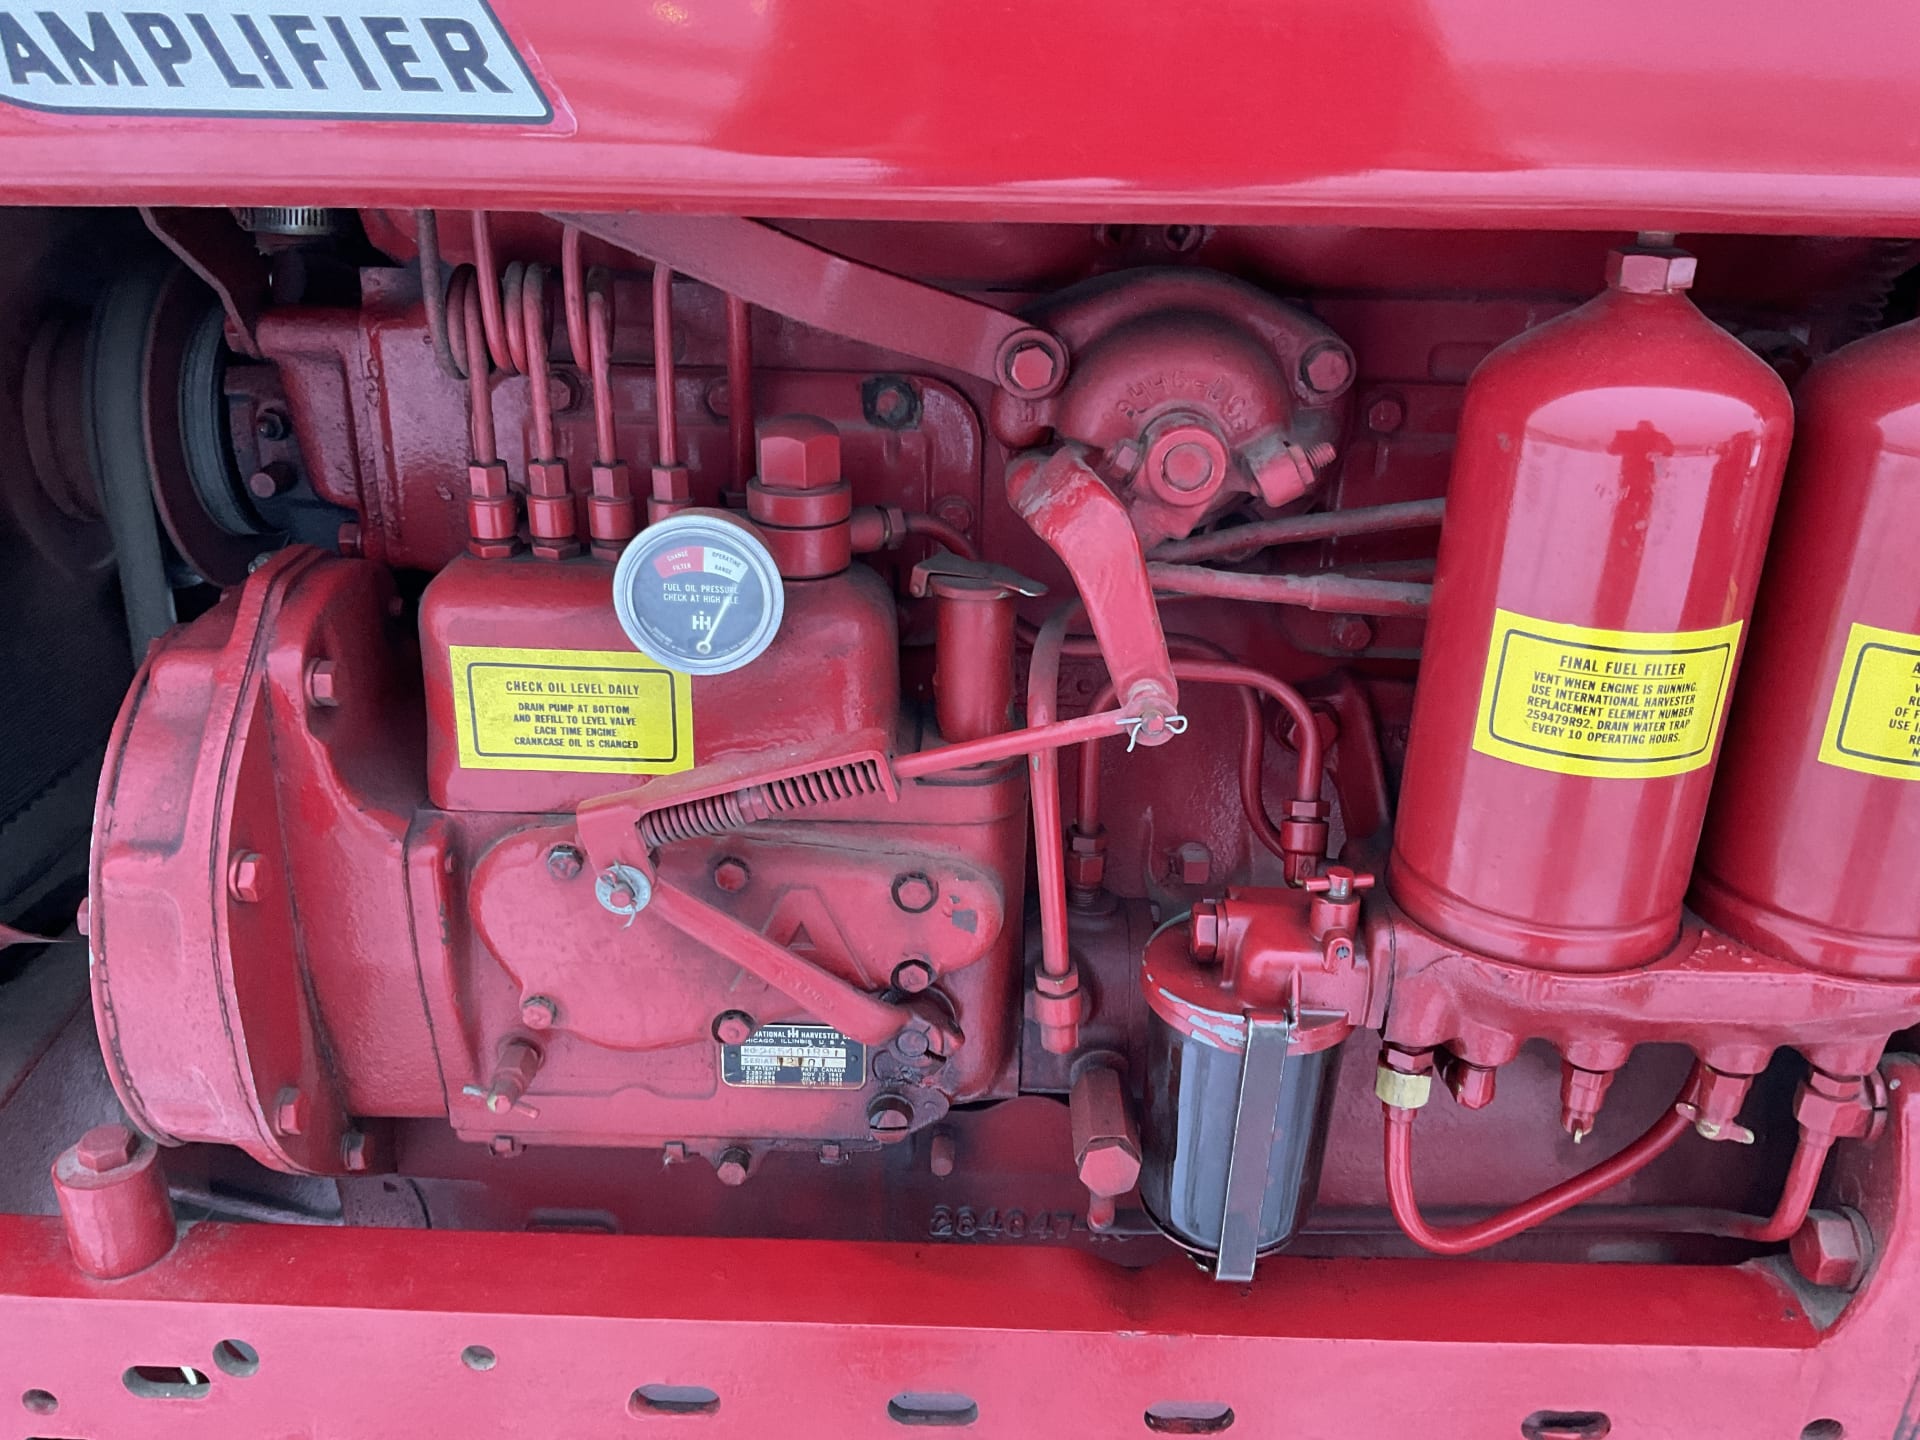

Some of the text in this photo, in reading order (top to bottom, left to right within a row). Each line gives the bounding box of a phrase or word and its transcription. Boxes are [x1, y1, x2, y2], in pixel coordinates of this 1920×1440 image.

[0, 10, 514, 95] AMPLIFIER
[666, 550, 688, 562] CHANGE
[712, 551, 741, 568] OPERATING
[672, 562, 691, 571] FILTER
[715, 564, 733, 575] RANGE
[663, 583, 739, 594] FUEL OIL PRESSURE
[663, 593, 688, 602] CHECK
[690, 594, 700, 603] AT
[704, 595, 721, 604] HIGH
[1560, 655, 1686, 676] FINAL FUEL FILTER
[506, 680, 640, 695] CHECK OIL LEVEL DAILY
[1533, 671, 1561, 685] VENT
[1564, 677, 1596, 691] WHEN
[1600, 682, 1640, 695] ENGINE
[1643, 684, 1653, 695] IS
[1531, 683, 1696, 707] USE INTERNATIONAL HARVESTER
[518, 702, 630, 714] DRAIN PUMP AT BOTTOM
[1527, 695, 1694, 720] REPLACEMENT ELEMENT NUMBER
[1895, 707, 1909, 718] OF
[513, 713, 637, 726] AND REFILL TO LEVEL VALVE
[1526, 708, 1690, 732] 259479R92. DRAIN WATER TRAP
[1889, 719, 1910, 731] USE
[534, 726, 617, 737] EACH TIME ENGINE
[1531, 722, 1681, 744] EVERY 10 OPERATING HOURS.
[514, 737, 639, 749] CRANKCASE OIL IS CHANGED
[801, 1032, 839, 1040] HARVESTER
[743, 1057, 774, 1065] SERIAL
